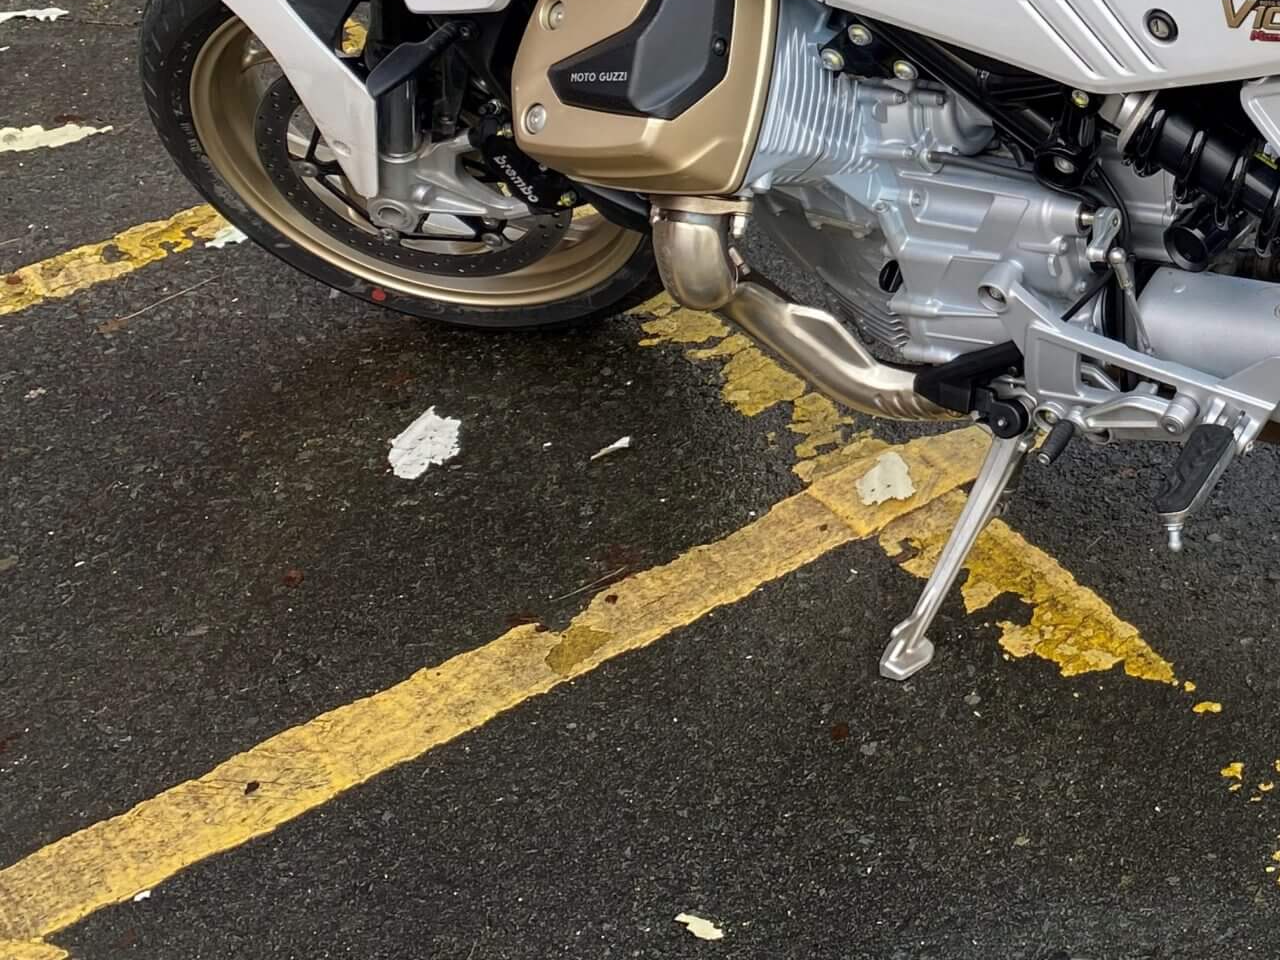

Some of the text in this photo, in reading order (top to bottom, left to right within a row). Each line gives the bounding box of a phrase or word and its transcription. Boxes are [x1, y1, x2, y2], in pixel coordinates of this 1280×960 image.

[570, 71, 628, 83] MOTO GUZZI
[493, 154, 539, 203] brembo
